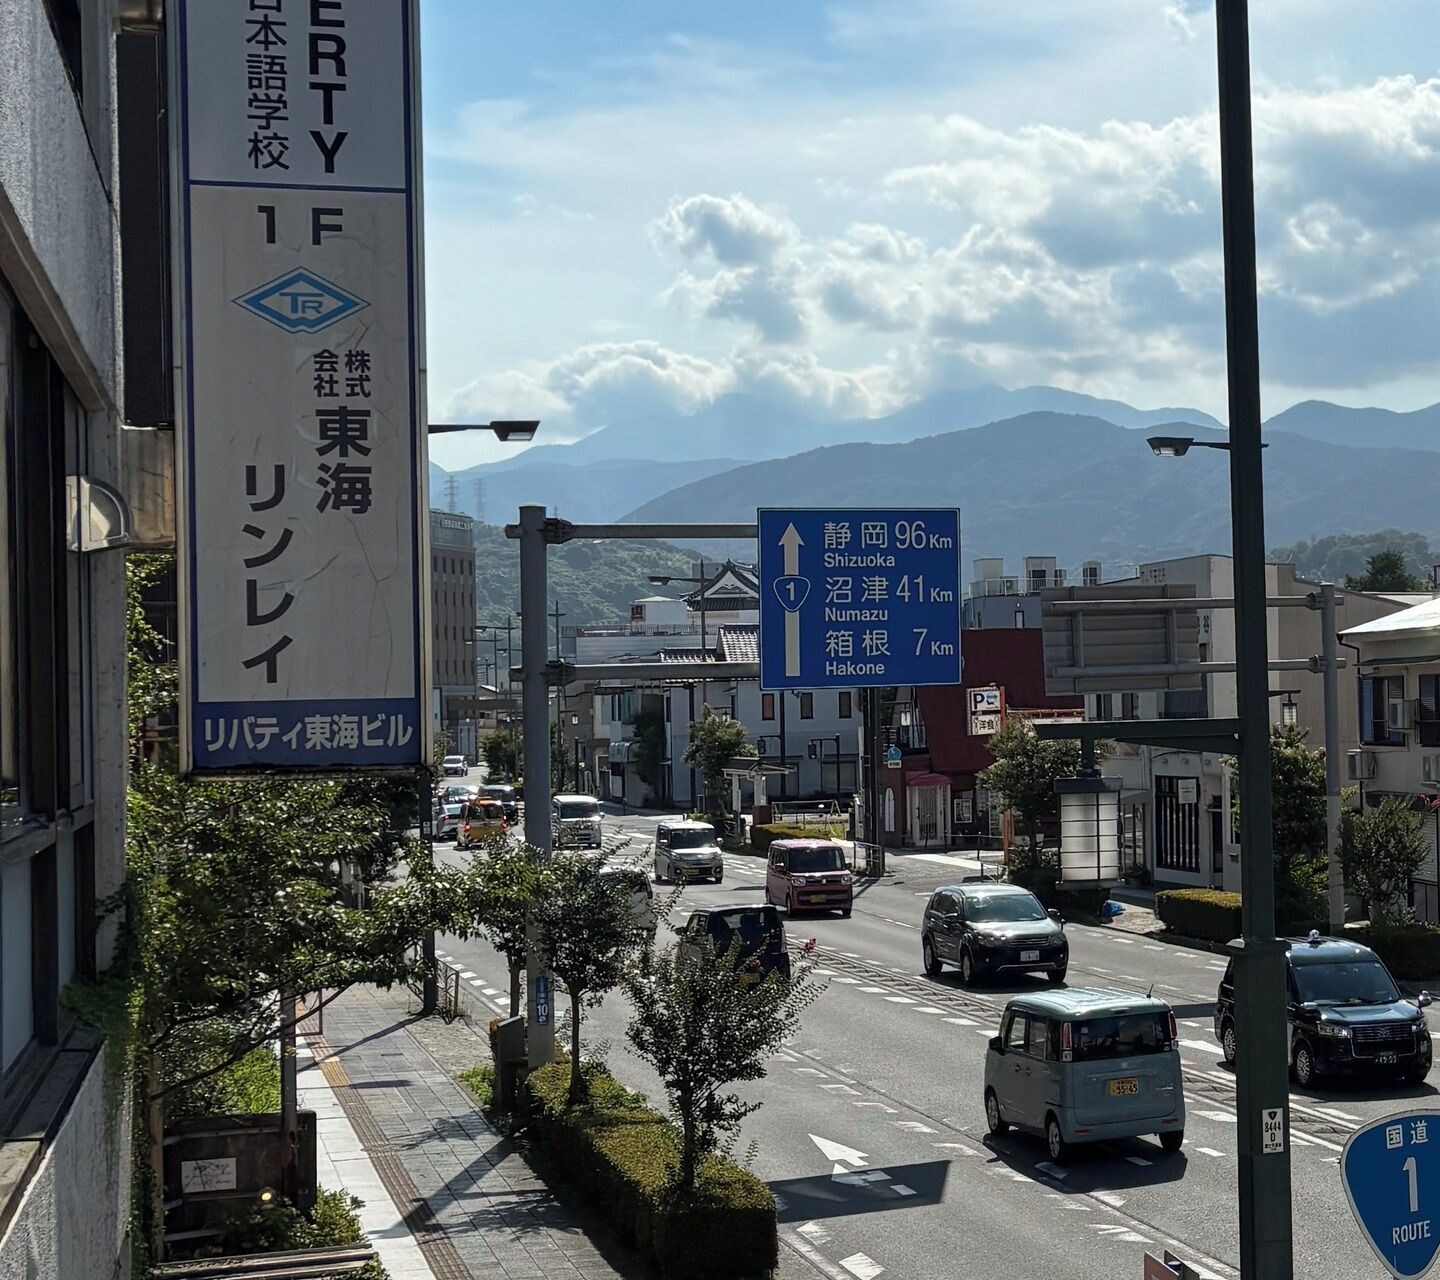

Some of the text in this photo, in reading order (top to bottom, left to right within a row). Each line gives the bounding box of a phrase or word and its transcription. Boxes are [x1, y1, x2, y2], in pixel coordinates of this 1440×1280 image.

[256, 205, 344, 246] 1F
[314, 405, 373, 515] 東海
[824, 521, 890, 549] 静岡
[241, 463, 294, 684] リンレイ
[824, 553, 895, 568] Shizuoka
[786, 582, 795, 601] 1
[825, 576, 889, 603] 沼津
[825, 608, 888, 621] Numazu
[825, 629, 891, 657] 箱根
[825, 661, 885, 675] Hakone
[973, 693, 985, 710] P
[203, 713, 413, 753] リバティ東海ビル
[1386, 1120, 1428, 1149] 国道
[1402, 1156, 1418, 1212] 1
[1392, 1220, 1431, 1245] ROUTE
